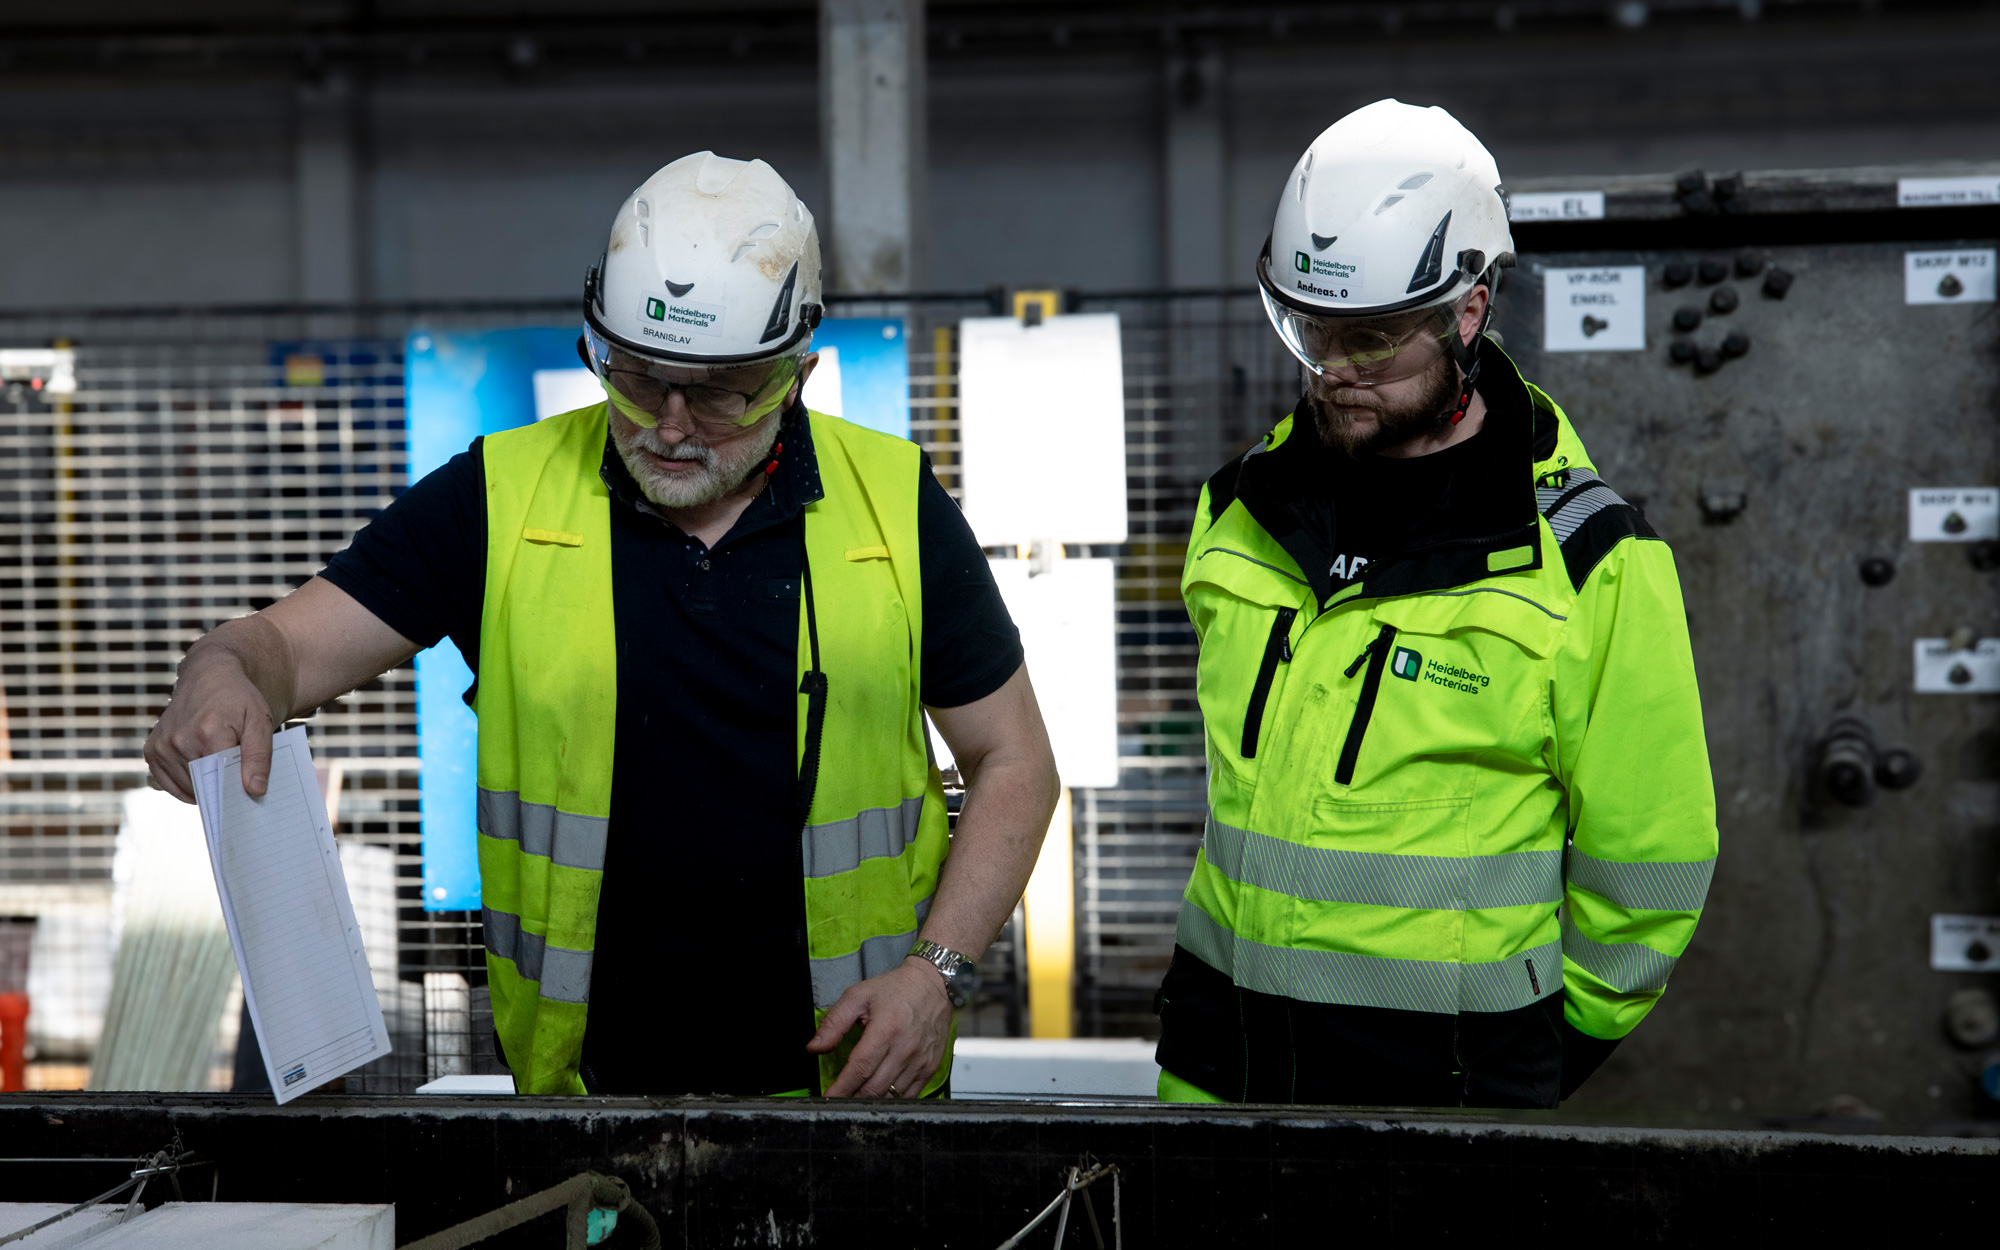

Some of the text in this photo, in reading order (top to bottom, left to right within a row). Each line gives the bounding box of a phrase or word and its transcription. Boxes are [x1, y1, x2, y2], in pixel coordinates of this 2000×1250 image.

[1312, 258, 1356, 273] Heidelberg
[1312, 266, 1350, 279] Materials
[1297, 279, 1338, 298] Andreas.
[1571, 293, 1617, 306] ENKEL
[668, 313, 709, 328] Materials
[669, 305, 716, 322] Heidelberg
[643, 326, 692, 345] BRANISLAV
[1427, 659, 1490, 687] Heidelberg
[1423, 670, 1479, 695] Materials
